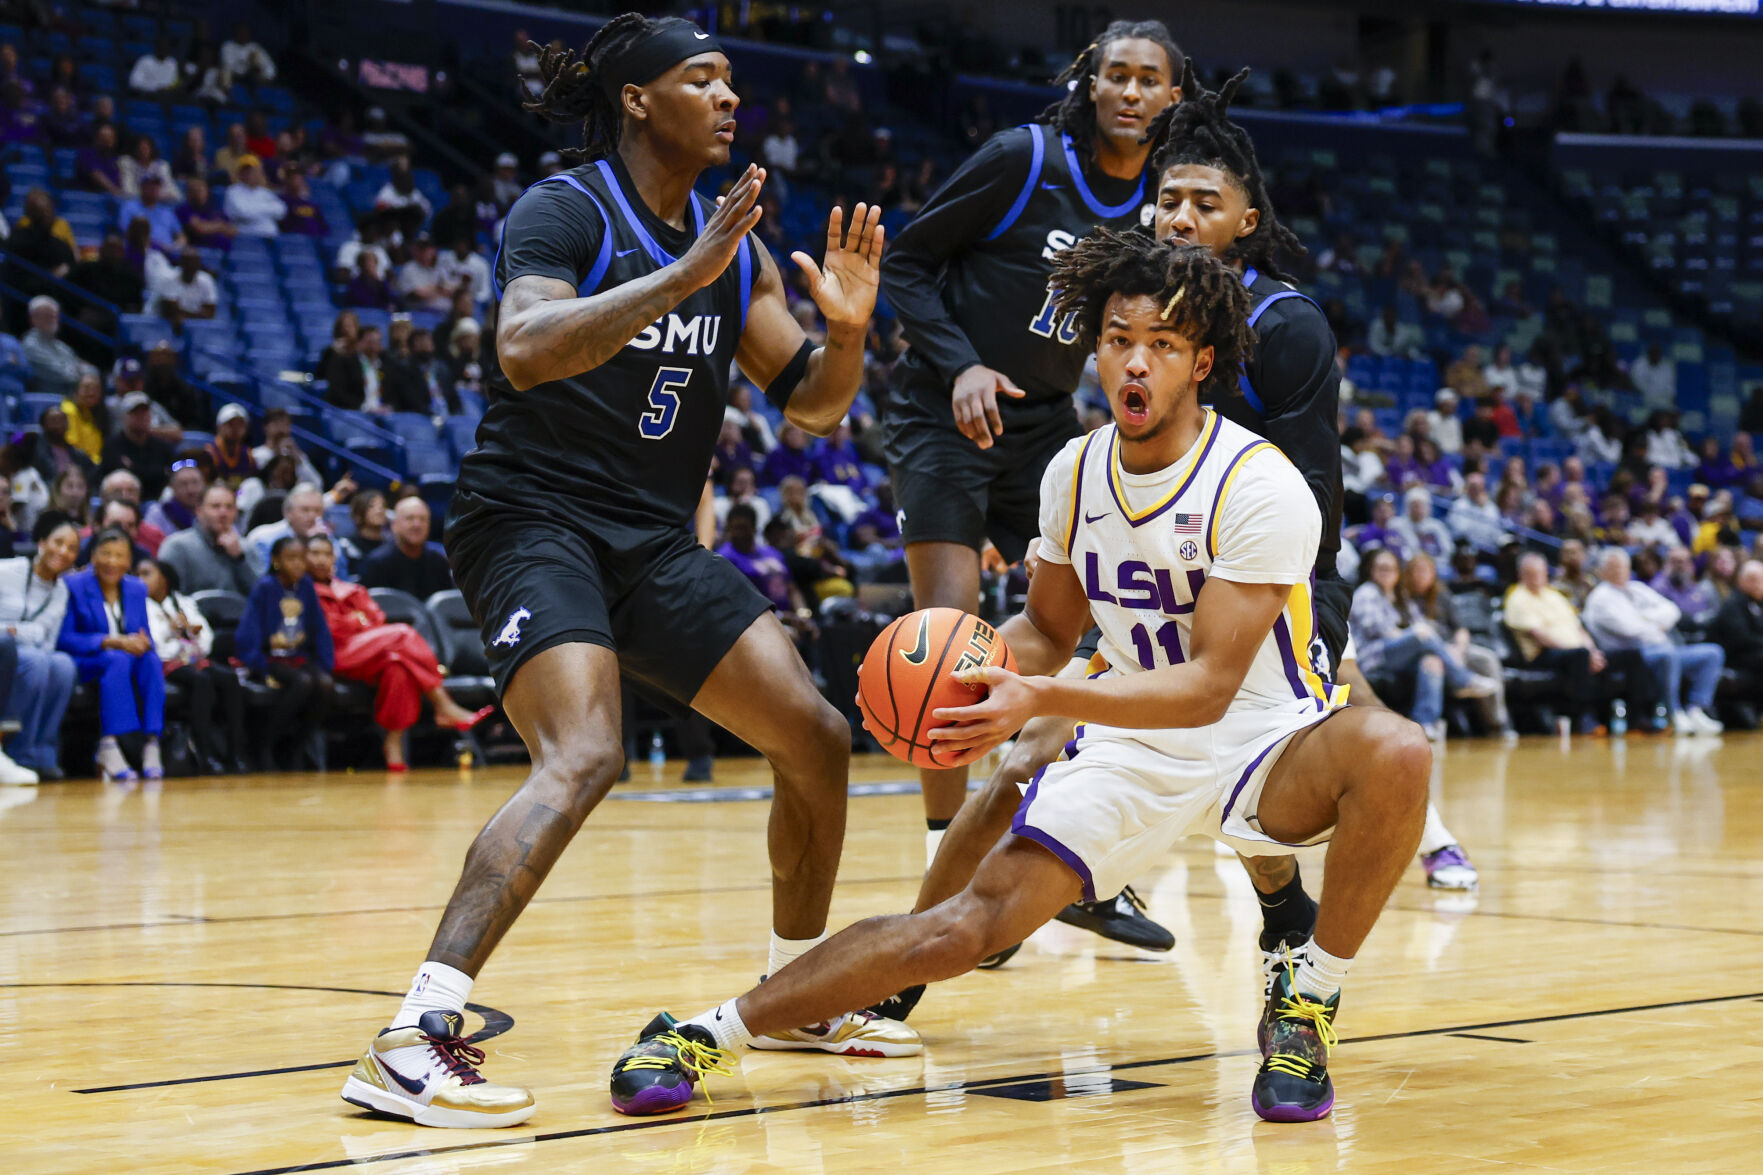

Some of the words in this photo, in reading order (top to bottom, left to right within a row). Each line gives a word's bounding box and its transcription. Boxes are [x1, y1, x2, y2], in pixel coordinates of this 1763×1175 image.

[625, 313, 721, 356] SMU
[638, 366, 693, 440] 5
[1180, 541, 1198, 560] SEC
[1086, 552, 1205, 614] LSU
[1131, 621, 1186, 670] 11
